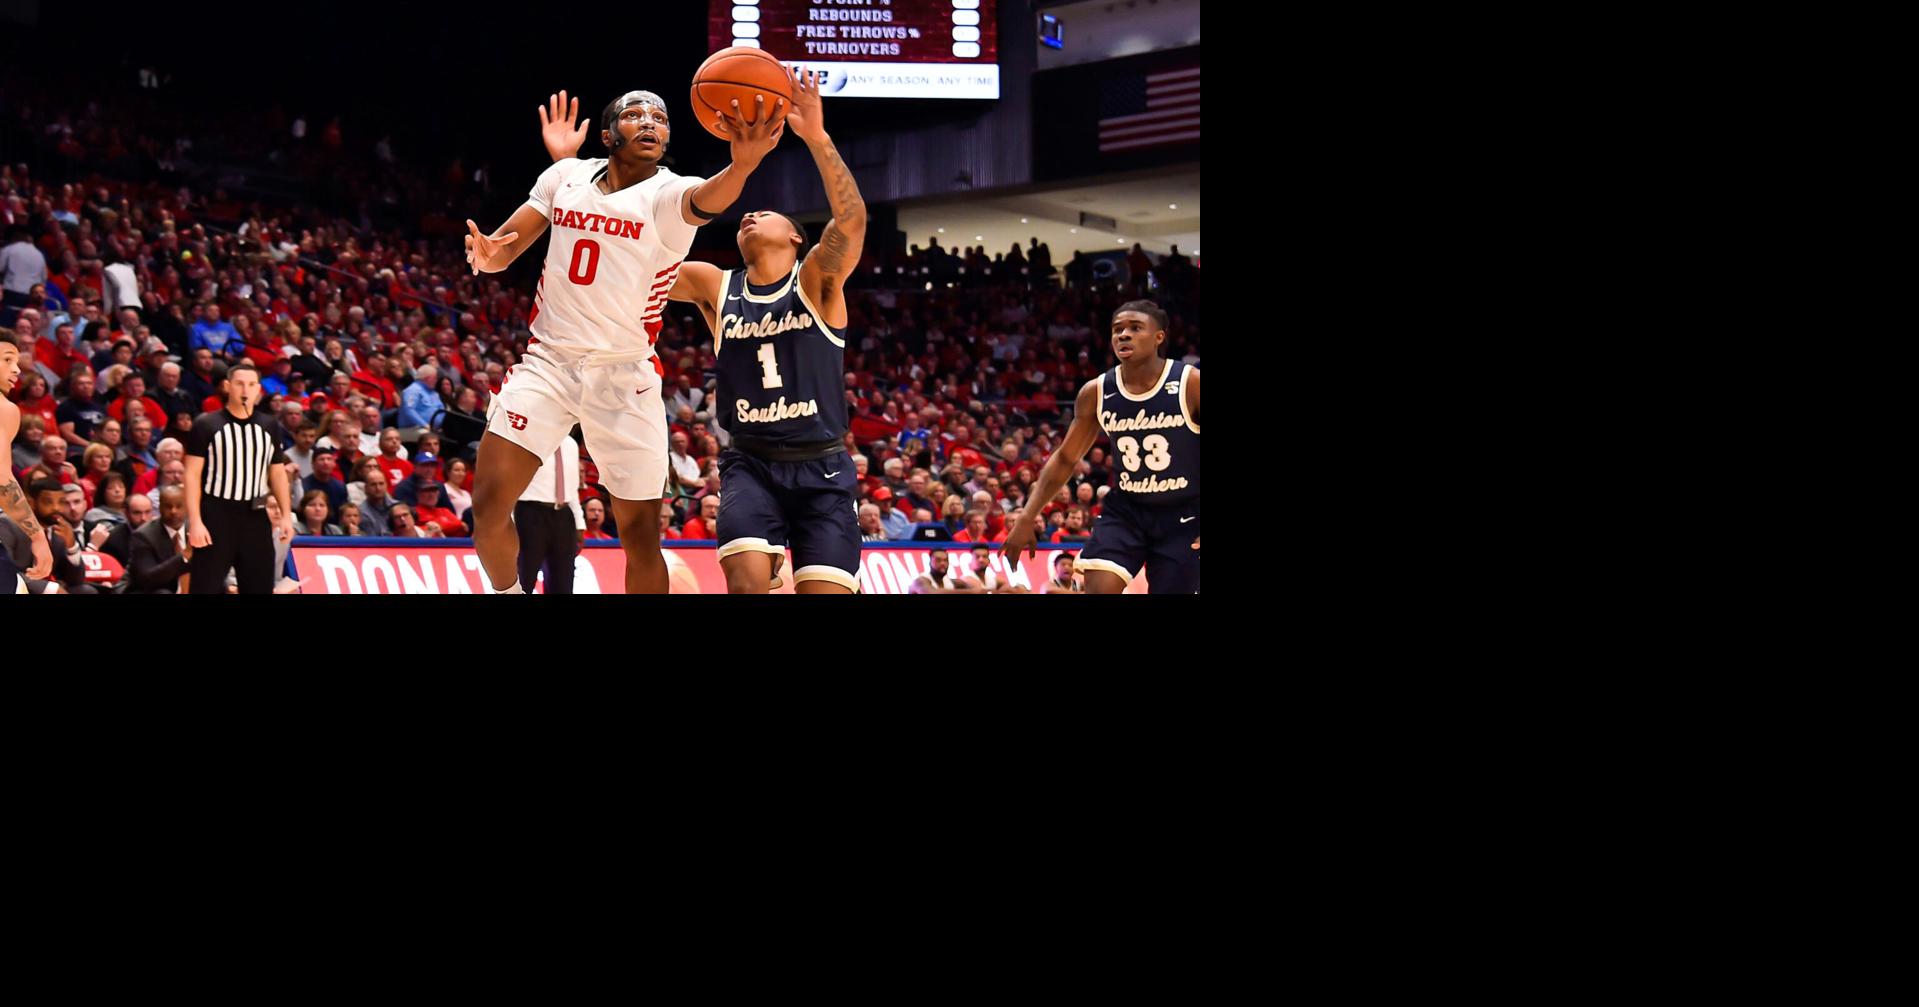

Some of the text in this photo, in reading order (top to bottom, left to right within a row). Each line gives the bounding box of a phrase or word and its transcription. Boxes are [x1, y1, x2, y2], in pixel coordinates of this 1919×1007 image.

[809, 8, 893, 22] REBOUNDS
[796, 24, 837, 38] FREE
[804, 41, 900, 55] TURNOVERS
[850, 75, 874, 85] ANY
[937, 76, 960, 86] ANY
[967, 76, 993, 86] TIME
[553, 207, 644, 240] DAYTON
[568, 238, 600, 286] 0
[757, 342, 783, 390] 1
[736, 396, 818, 423] Southern
[1101, 408, 1185, 432] Charleston
[1117, 434, 1172, 472] 33
[1119, 472, 1189, 493] Southern
